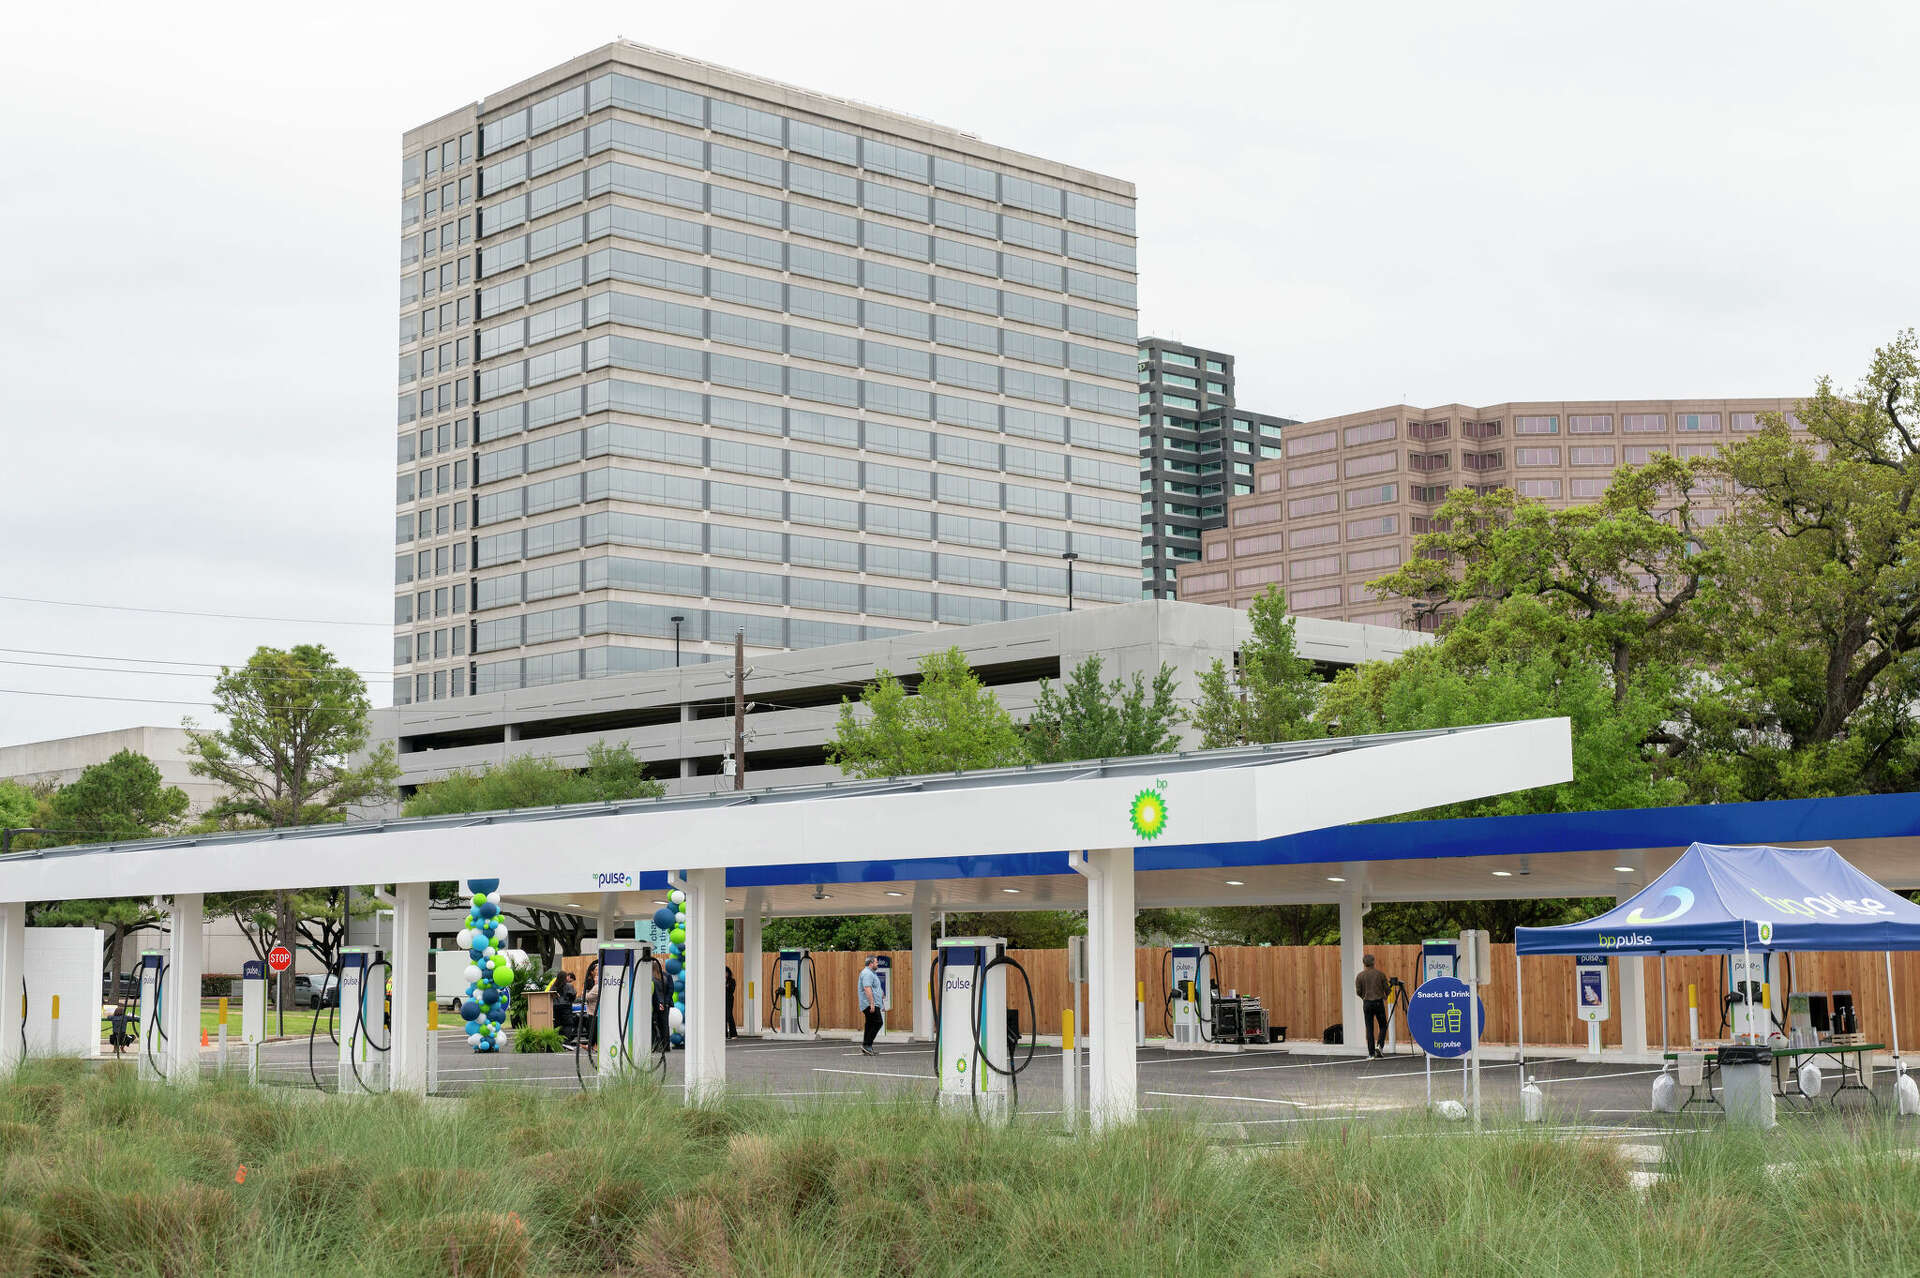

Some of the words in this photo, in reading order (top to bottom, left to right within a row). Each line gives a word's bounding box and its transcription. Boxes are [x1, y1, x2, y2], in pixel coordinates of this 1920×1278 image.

[1156, 778, 1168, 790] bp
[598, 872, 625, 888] pulse
[271, 953, 289, 963] STOP
[1735, 961, 1755, 971] pue
[344, 975, 358, 986] pulse
[603, 976, 621, 988] pulse
[946, 977, 970, 992] pulse
